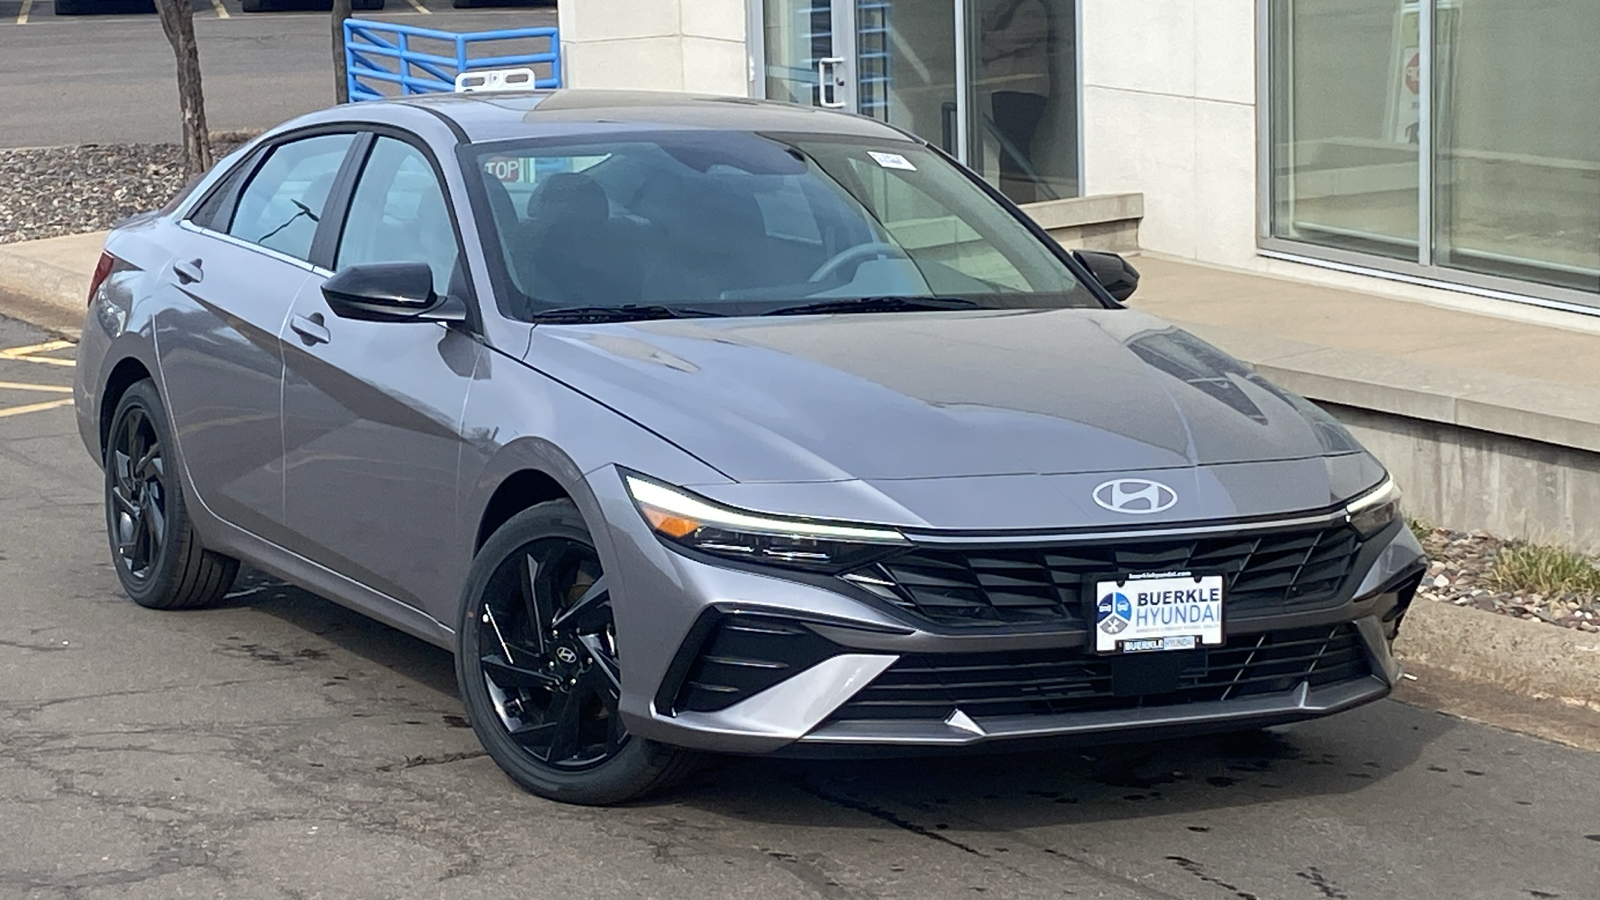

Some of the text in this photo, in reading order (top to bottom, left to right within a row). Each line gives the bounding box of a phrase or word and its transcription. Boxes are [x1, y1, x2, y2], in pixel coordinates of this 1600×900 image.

[484, 161, 518, 179] TOP
[1137, 588, 1220, 606] BUERKLE
[1136, 604, 1220, 627] HYUNDAI
[1125, 637, 1193, 651] BUERKLE HYUNDAI
